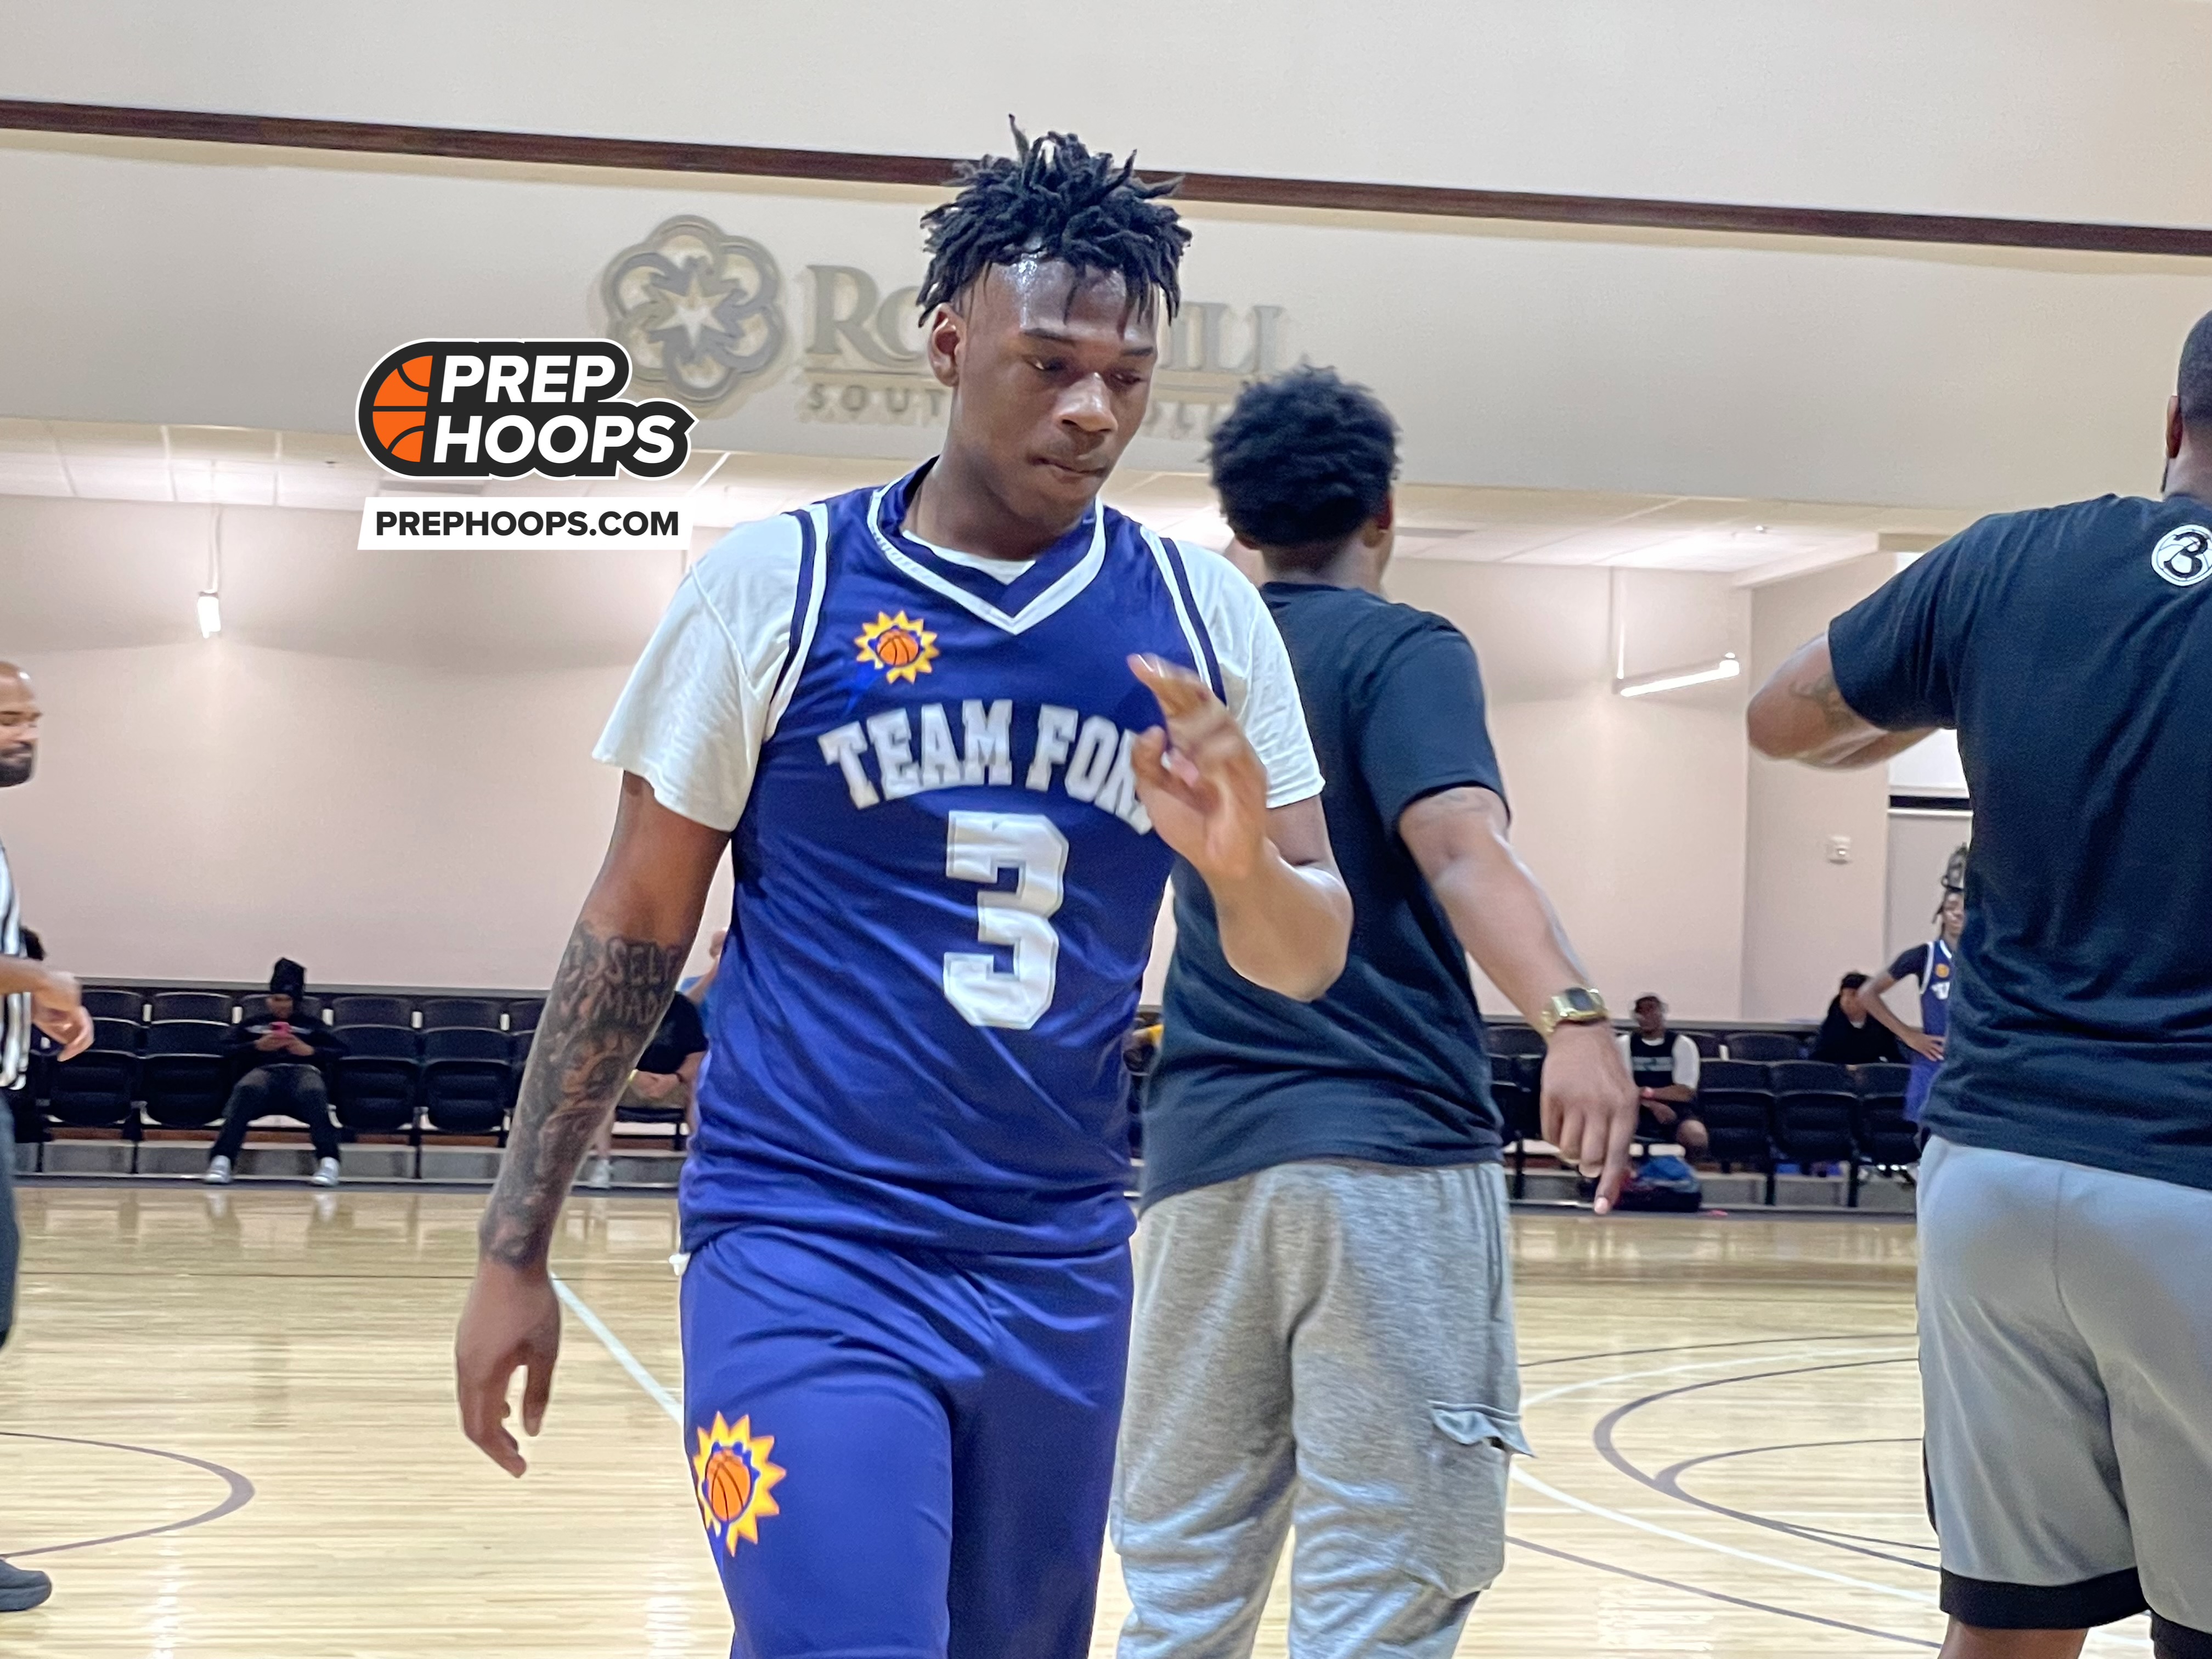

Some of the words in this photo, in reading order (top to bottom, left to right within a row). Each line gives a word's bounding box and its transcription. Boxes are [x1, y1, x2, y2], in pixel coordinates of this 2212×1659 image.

[807, 383, 946, 417] SOUT
[817, 699, 1013, 810] TEAM
[943, 810, 1069, 1030] 3
